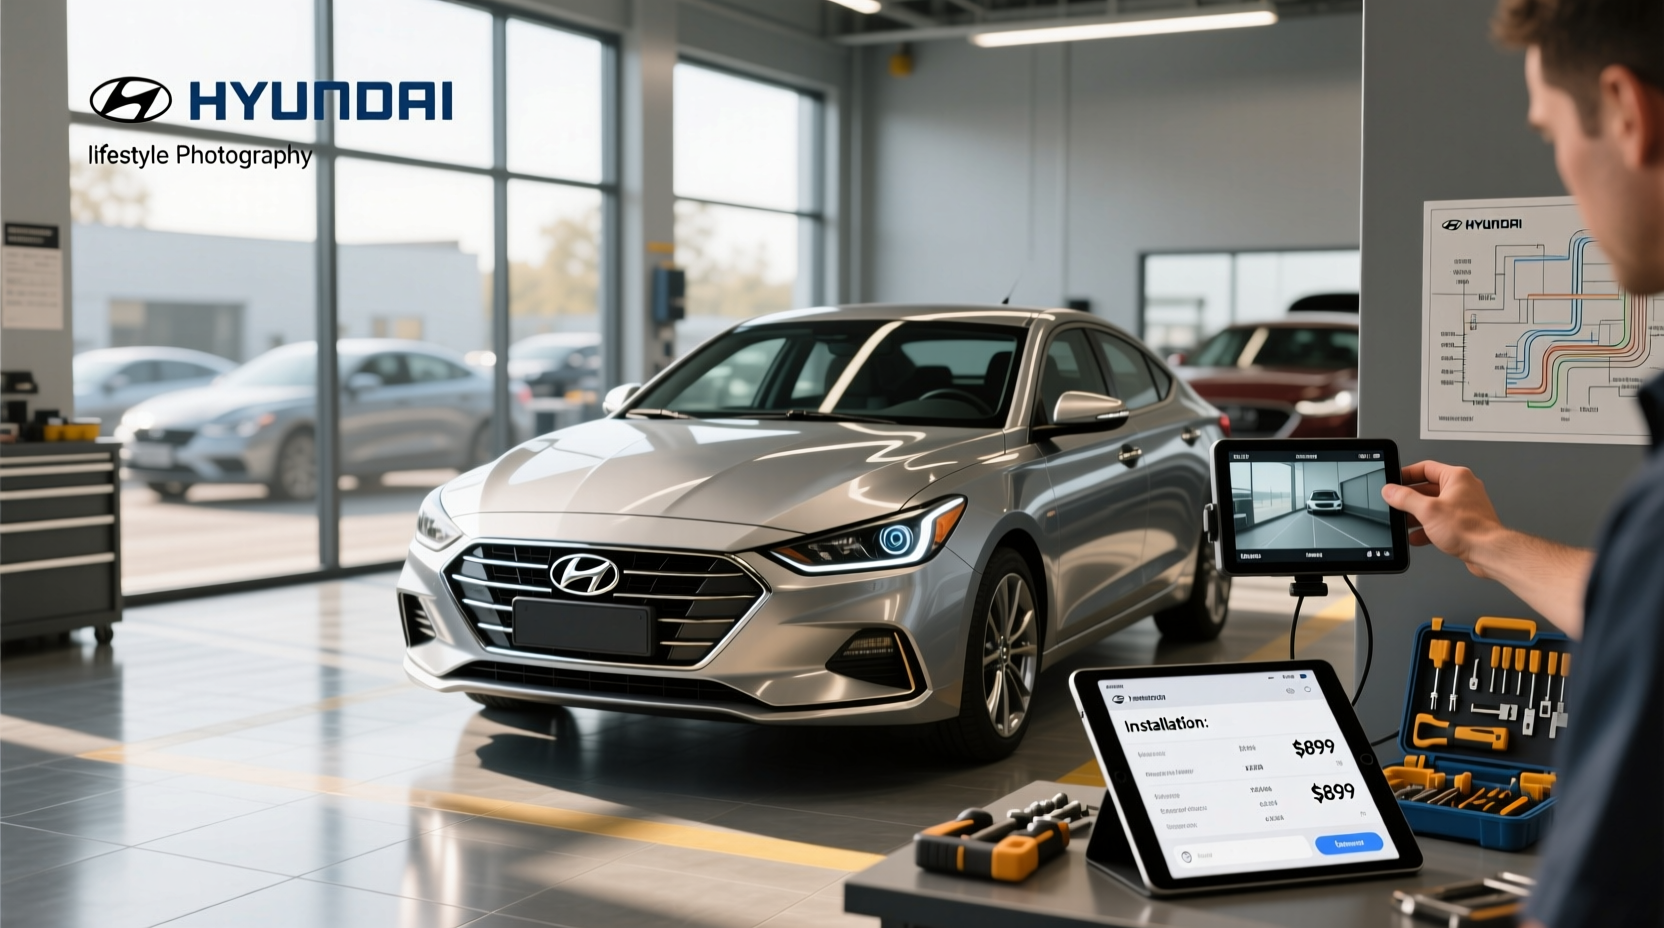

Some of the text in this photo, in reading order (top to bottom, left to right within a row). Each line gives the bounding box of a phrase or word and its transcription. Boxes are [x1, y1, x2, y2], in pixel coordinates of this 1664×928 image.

[1466, 219, 1522, 230] HYUNDAI
[1124, 715, 1209, 733] Installation:
[1292, 739, 1335, 758] $899
[1311, 782, 1355, 804] $899
